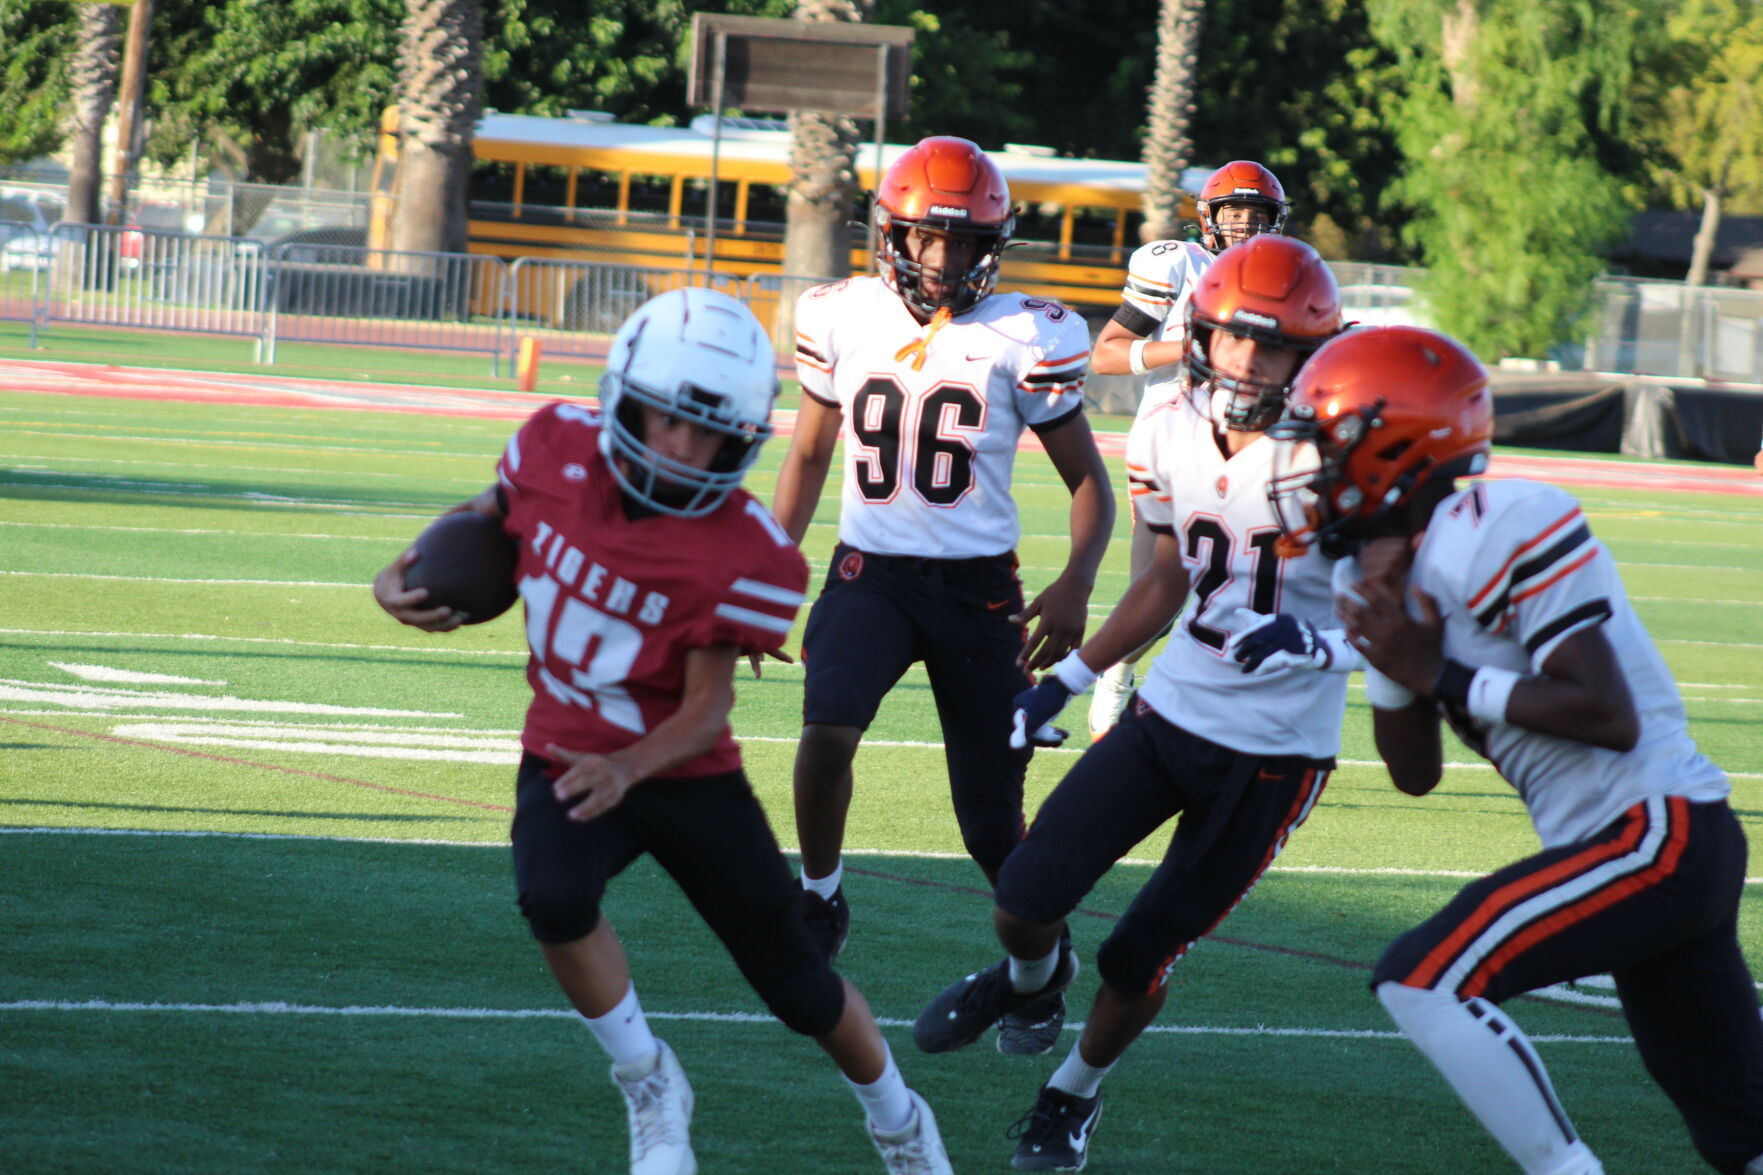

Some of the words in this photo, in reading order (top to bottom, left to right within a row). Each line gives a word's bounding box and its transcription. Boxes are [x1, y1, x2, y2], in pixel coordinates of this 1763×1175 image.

[852, 372, 988, 508] 96
[531, 520, 670, 626] TIGERS
[1182, 511, 1285, 658] 21
